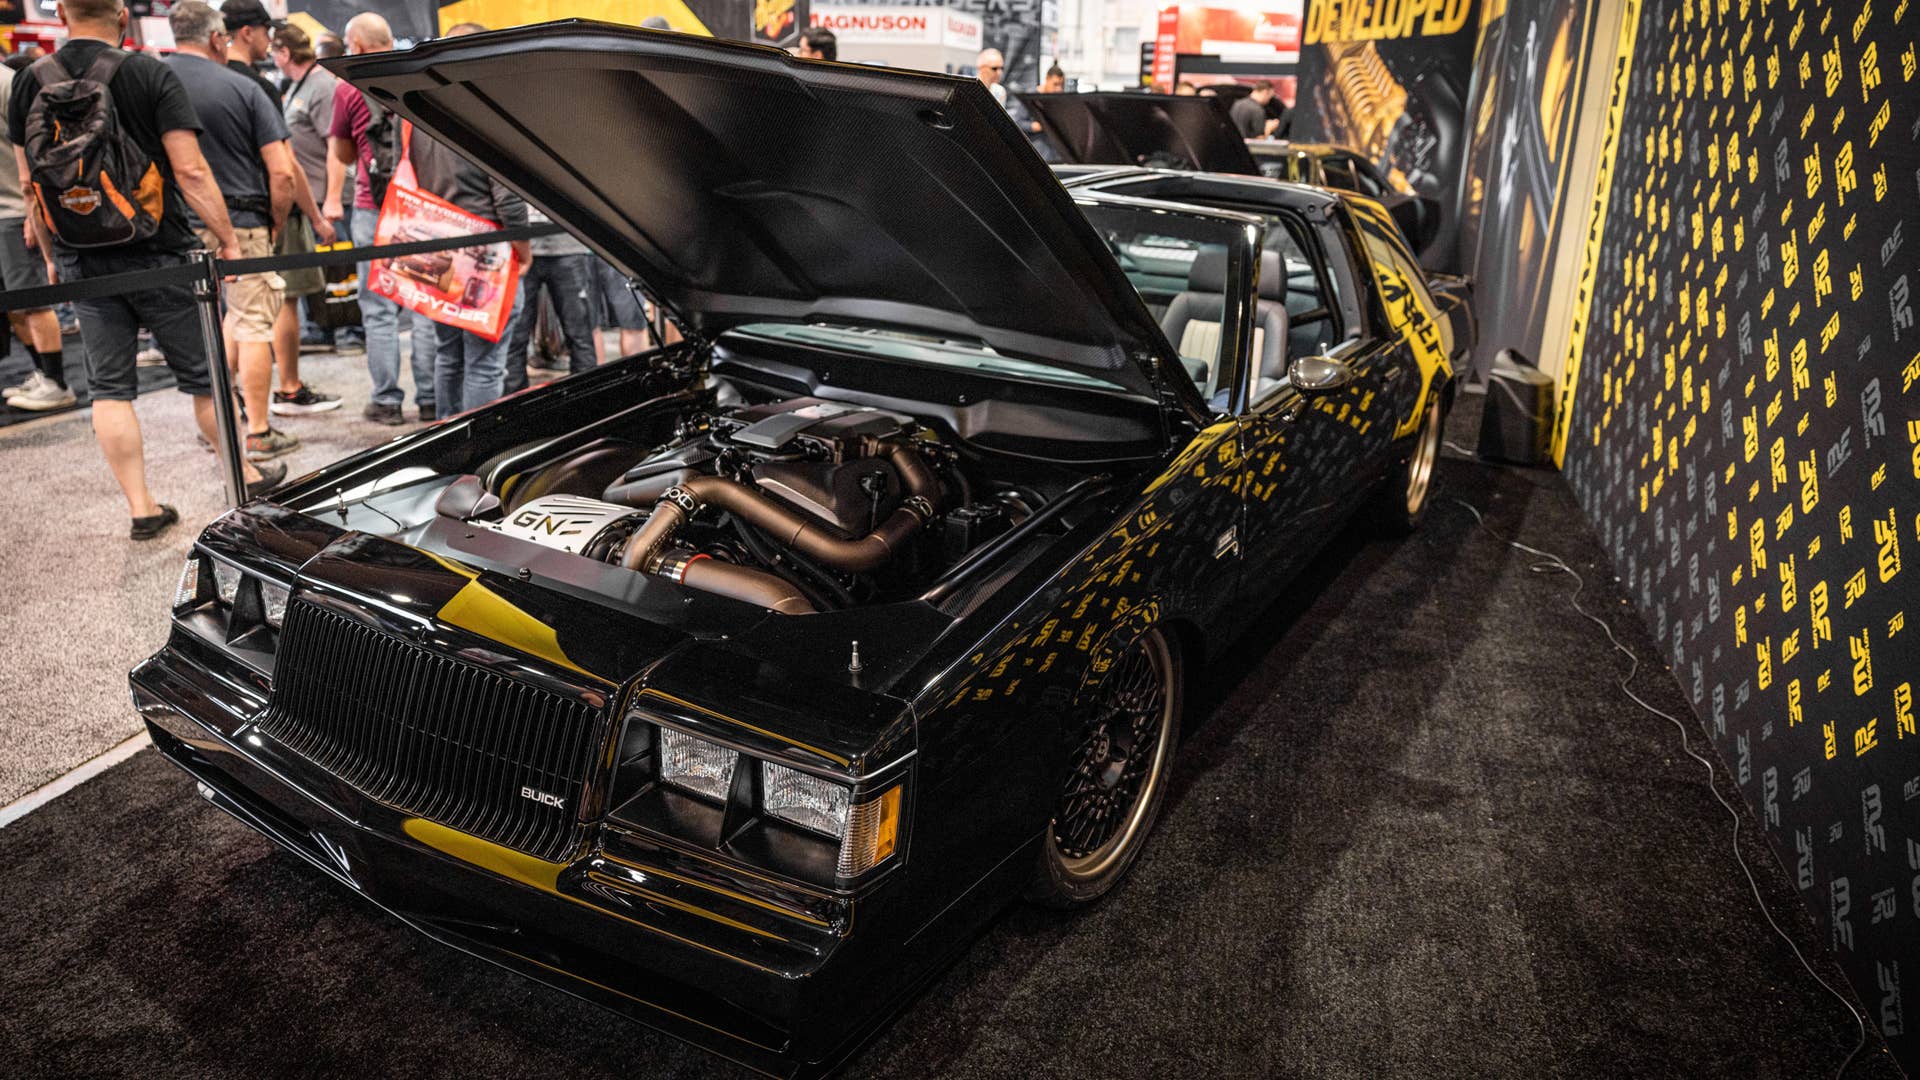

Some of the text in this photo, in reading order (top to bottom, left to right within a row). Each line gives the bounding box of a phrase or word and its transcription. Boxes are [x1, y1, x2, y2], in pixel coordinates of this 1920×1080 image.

[1304, 0, 1471, 45] DEVELOPED
[397, 286, 490, 325] SPYDER
[520, 786, 565, 810] BUICK
